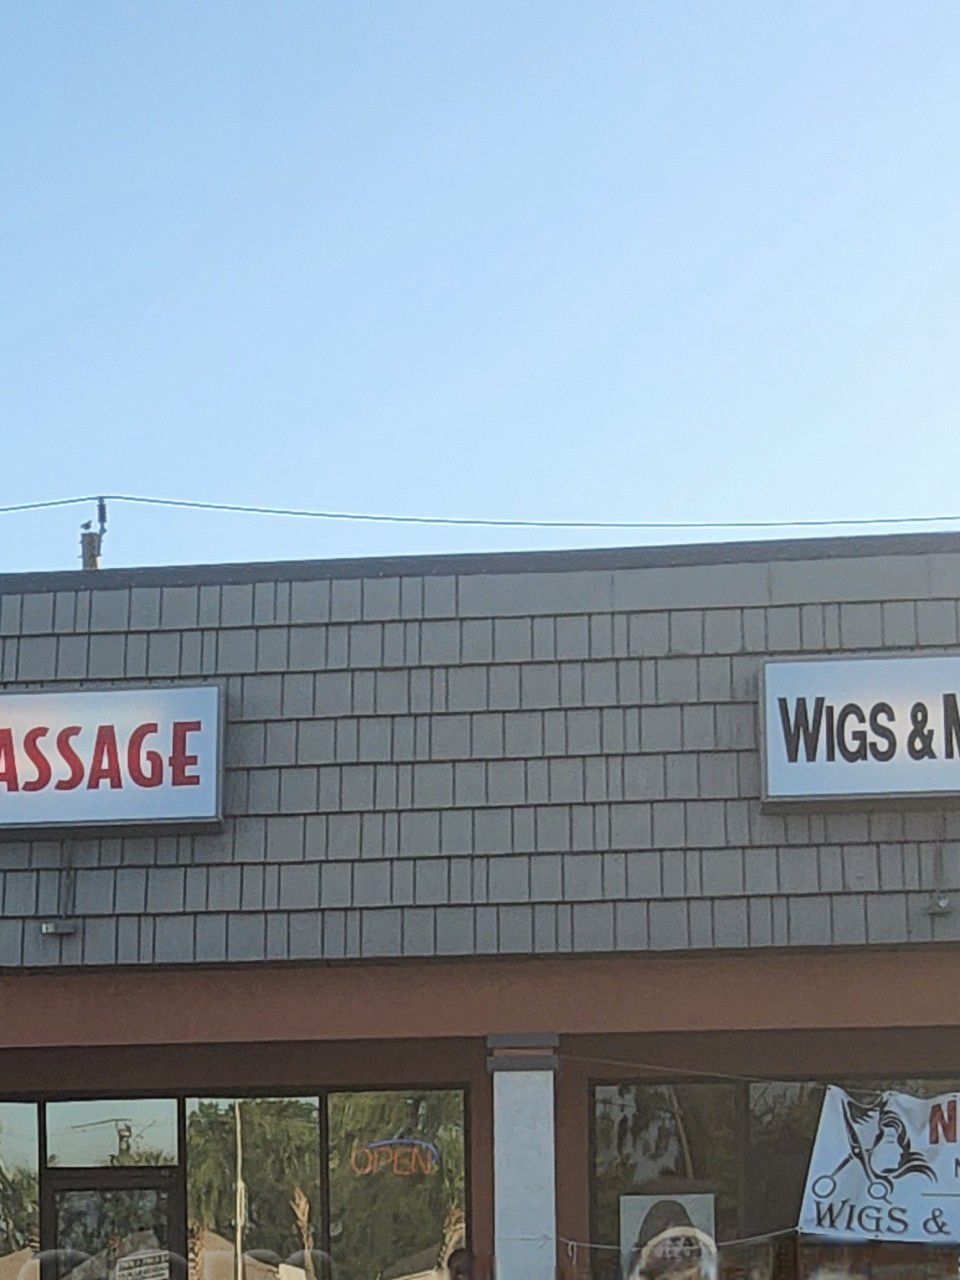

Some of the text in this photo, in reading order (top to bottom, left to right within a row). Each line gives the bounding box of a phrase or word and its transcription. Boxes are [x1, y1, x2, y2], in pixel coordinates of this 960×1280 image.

[777, 696, 897, 763] WIGS
[907, 701, 938, 761] &
[351, 1146, 432, 1175] OPEN
[814, 1198, 952, 1236] WIGS &
